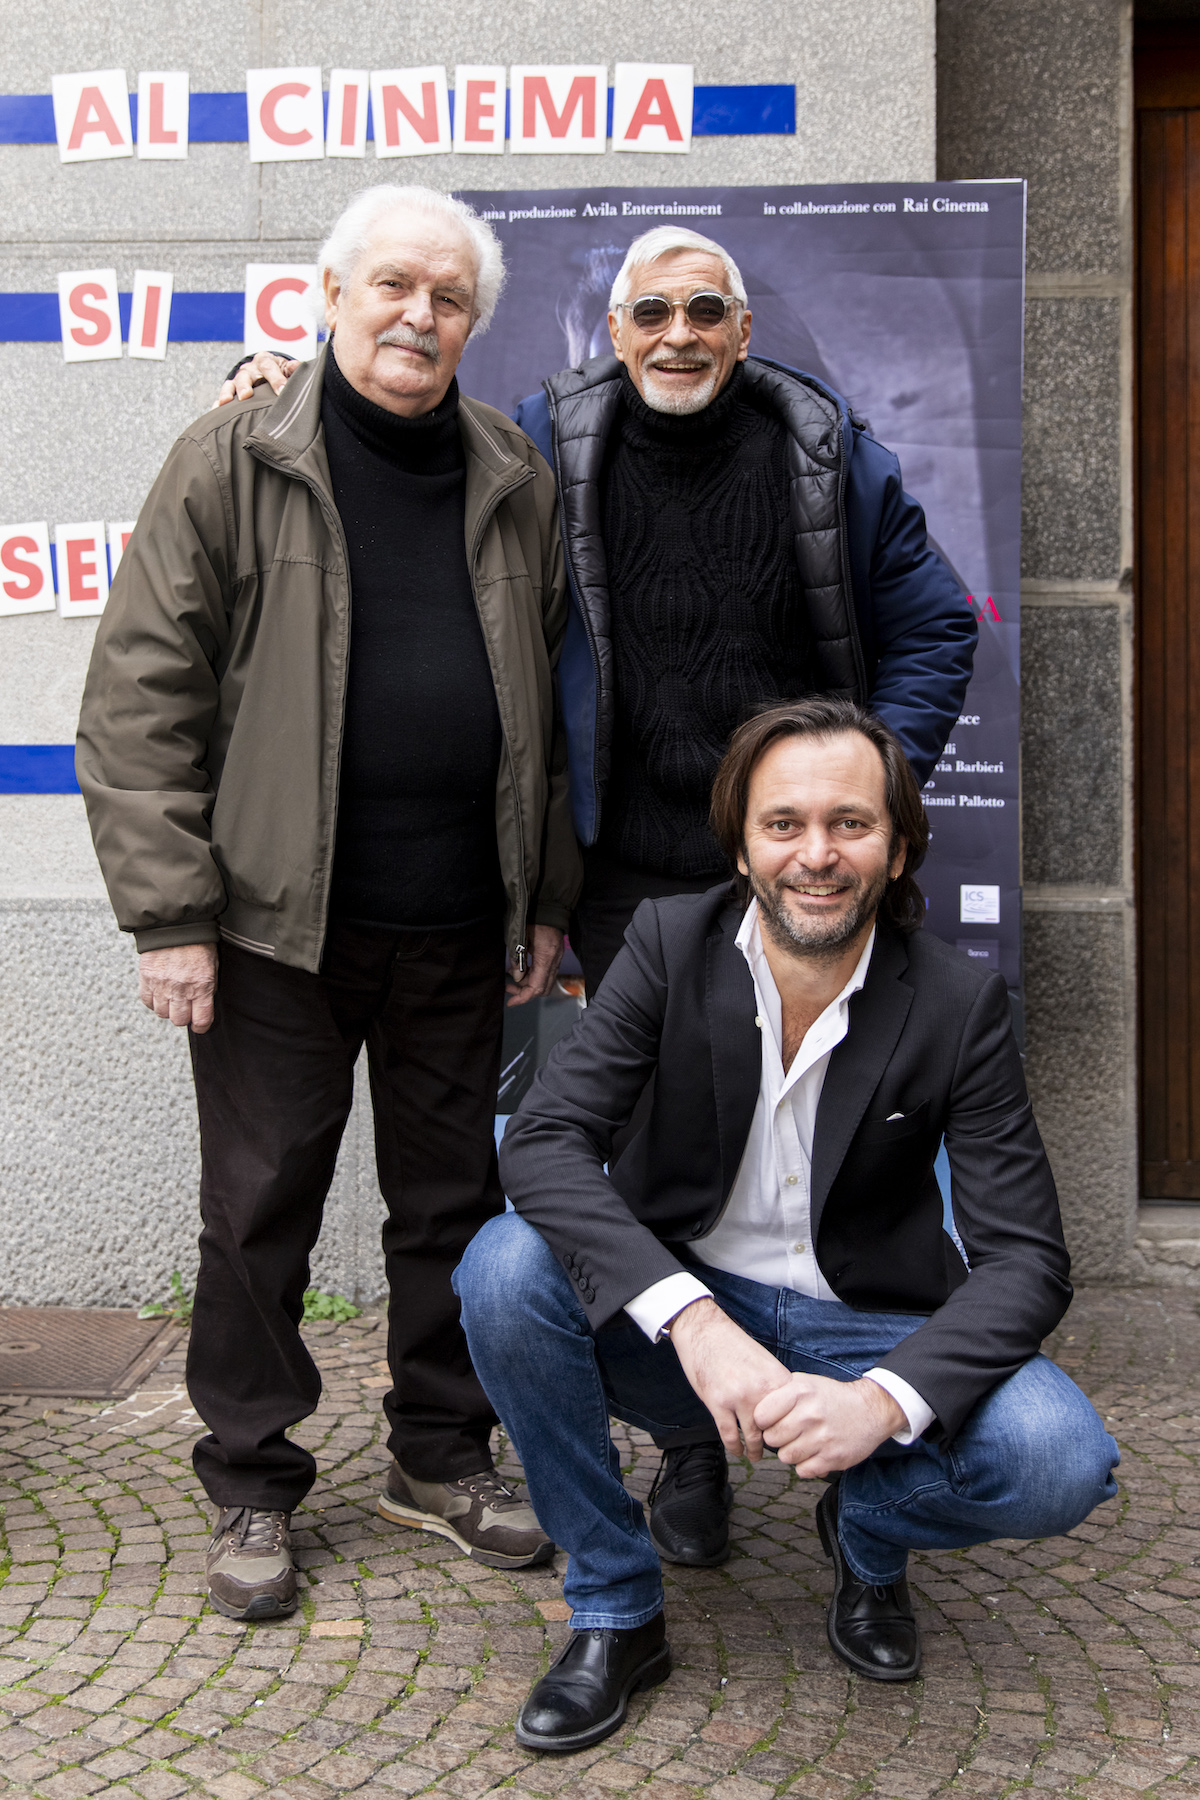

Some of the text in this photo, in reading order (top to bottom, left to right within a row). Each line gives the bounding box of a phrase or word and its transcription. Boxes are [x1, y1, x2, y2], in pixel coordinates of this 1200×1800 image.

[67, 76, 684, 150] AL CINEMA
[482, 198, 990, 222] una produzione Avila Entertainment in collaborazione con Rai Cinema
[69, 282, 161, 348] SI
[0, 532, 133, 602] SE
[956, 715, 981, 726] sce
[955, 760, 1004, 774] Barbieri
[958, 794, 1006, 809] Pallotto
[964, 890, 985, 902] ICS
